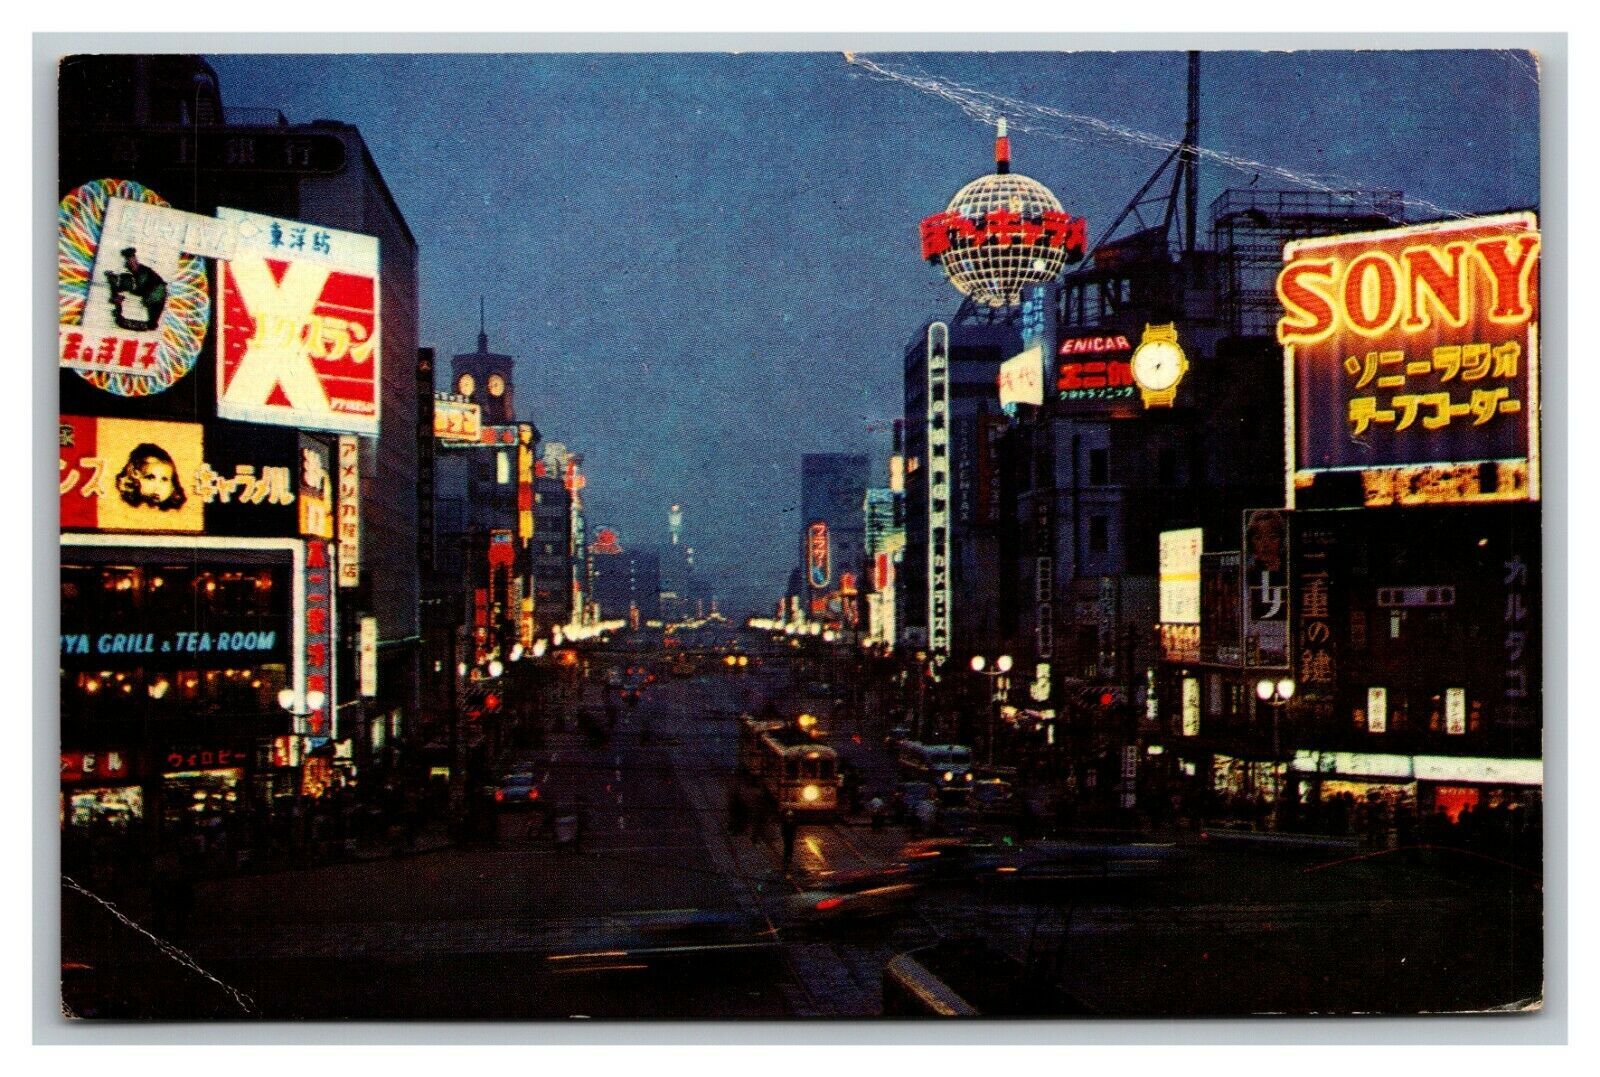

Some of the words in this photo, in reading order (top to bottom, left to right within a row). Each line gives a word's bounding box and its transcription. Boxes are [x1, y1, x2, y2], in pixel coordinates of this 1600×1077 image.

[1276, 231, 1540, 346] SONY
[1059, 334, 1131, 356] ENICAR
[1344, 340, 1521, 388] ソニーラジオ
[191, 462, 296, 505] キャラメル
[58, 634, 90, 653] YA
[97, 633, 154, 652] GRILL
